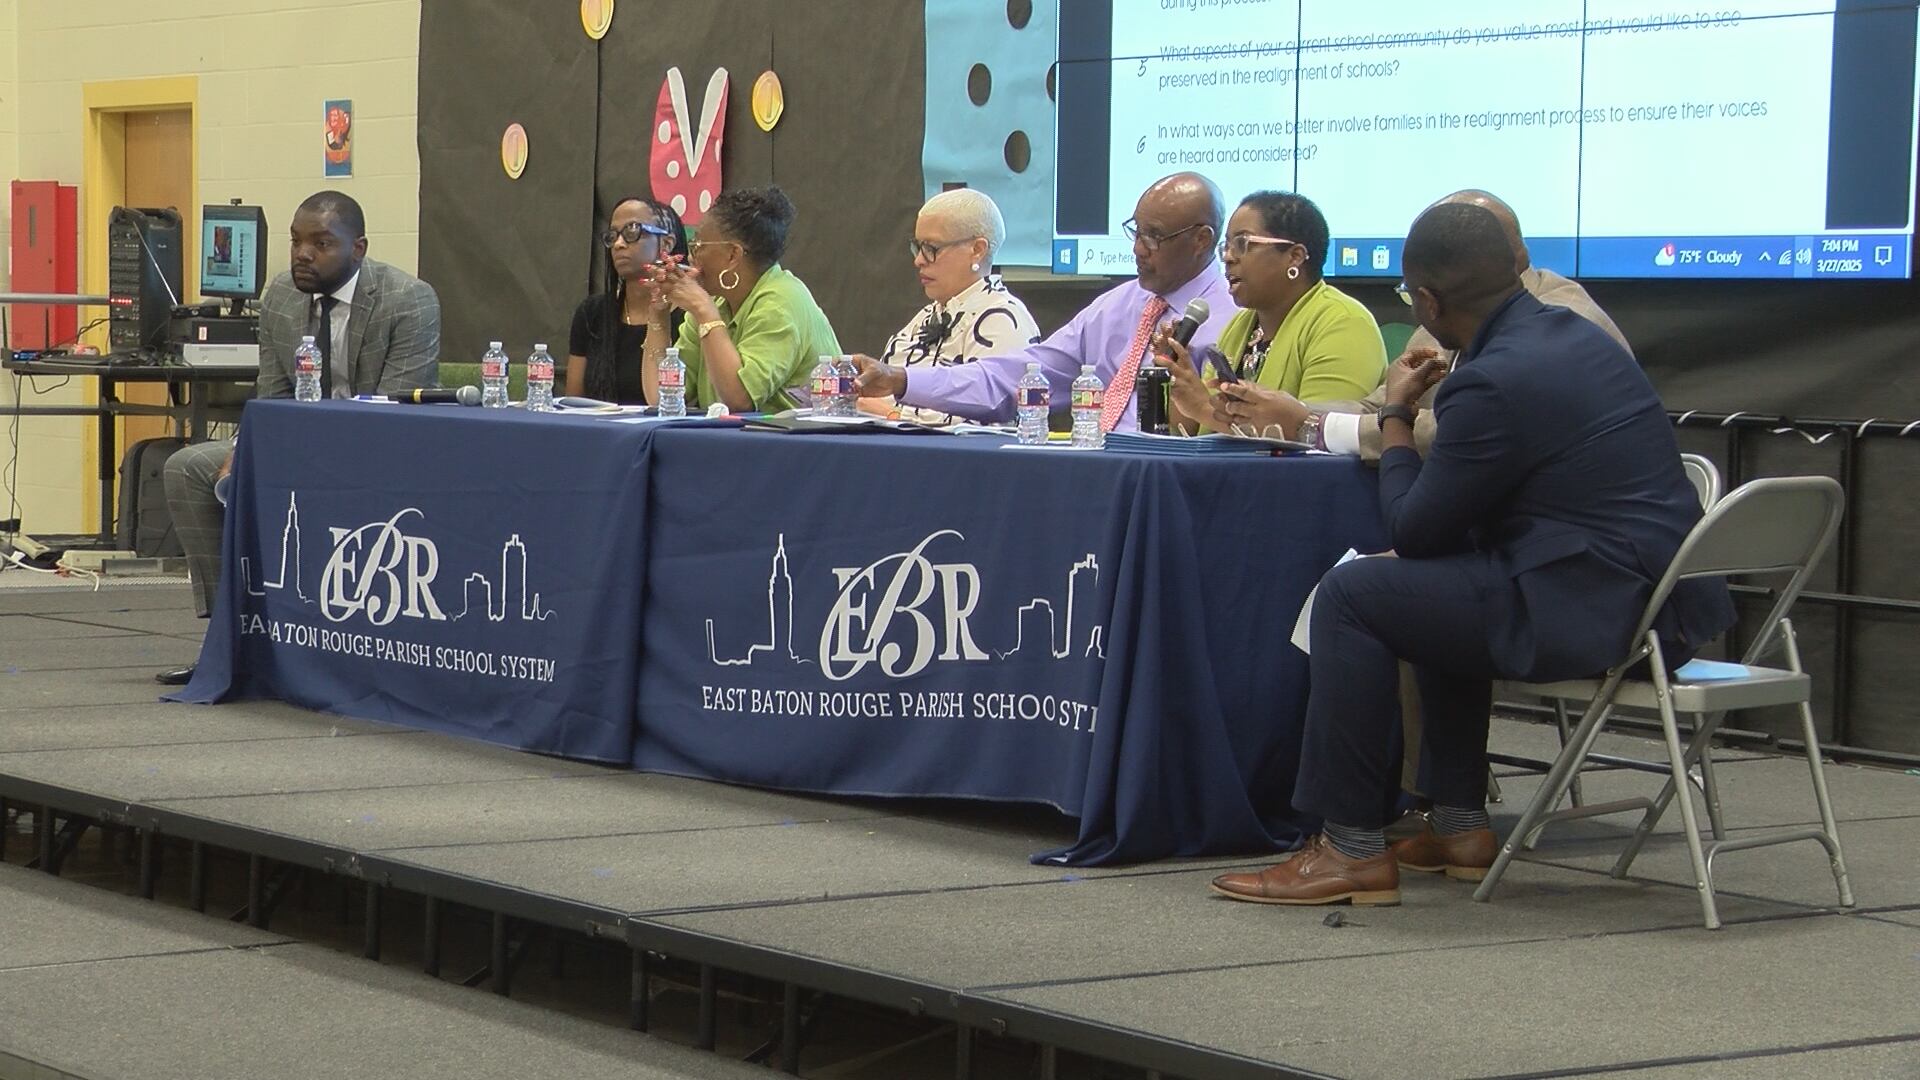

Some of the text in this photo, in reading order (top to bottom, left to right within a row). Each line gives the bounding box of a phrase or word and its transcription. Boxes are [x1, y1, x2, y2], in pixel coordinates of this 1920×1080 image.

[1160, 10, 1742, 62] What aspects of your current school community do you value most and would like to see
[1159, 59, 1400, 91] preserved in the realignment of schools?
[1158, 101, 1768, 140] In what ways can we better involve families in the realignment process to ensure their voices
[1157, 144, 1318, 164] are heard and considered?
[1100, 251, 1134, 265] Type here
[1706, 250, 1743, 267] Cloudy
[1841, 239, 1859, 252] PM
[1817, 259, 1863, 273] 3/27/2025
[320, 508, 447, 626] EBR
[819, 529, 990, 681] EBR
[240, 613, 555, 682] EA ATON ROUGE PARISH SCHOOL SYSTEM
[702, 685, 747, 712] EAST
[750, 689, 813, 716] BATON
[819, 692, 893, 718] ROUGE
[898, 692, 965, 718] PARISH
[973, 693, 1056, 721] SCHOO
